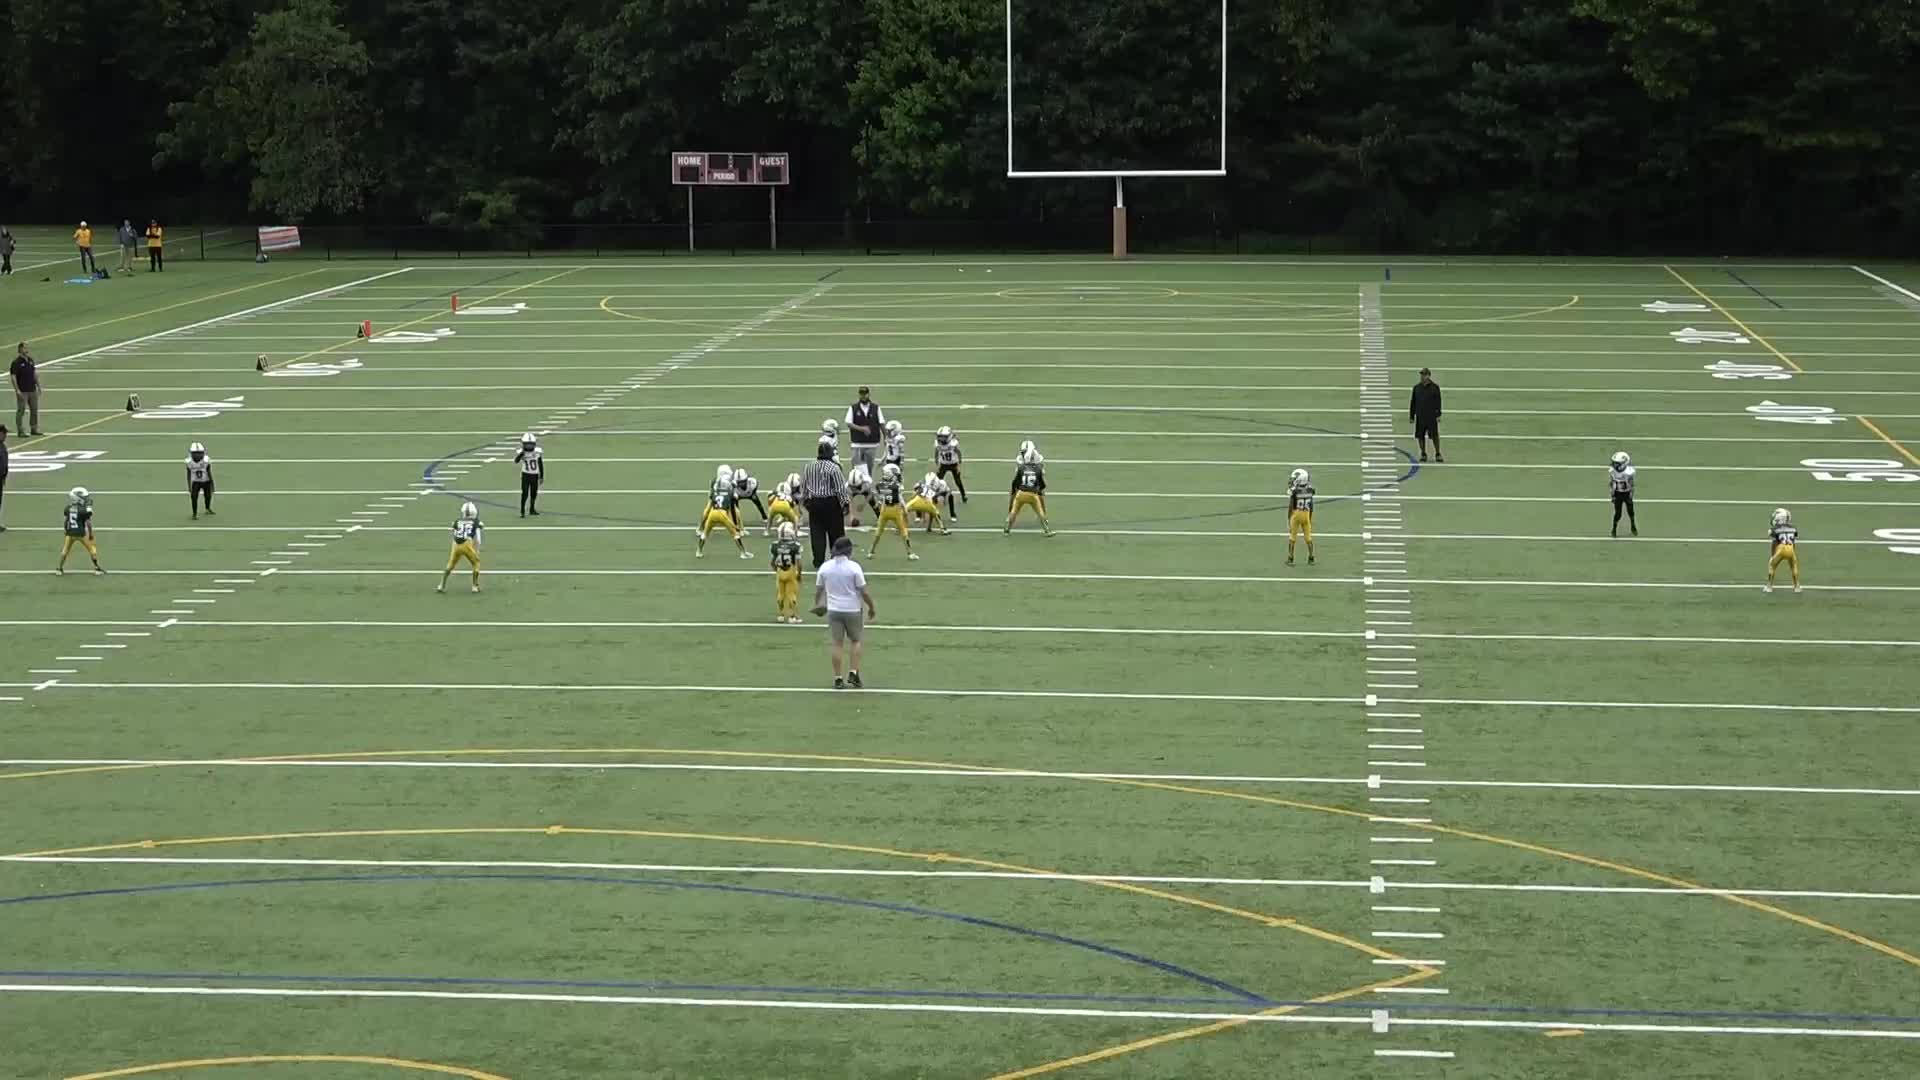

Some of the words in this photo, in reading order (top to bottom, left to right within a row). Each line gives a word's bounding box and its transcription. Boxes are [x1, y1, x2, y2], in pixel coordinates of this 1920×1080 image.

[677, 156, 702, 166] HOME
[759, 156, 786, 166] GUEST
[712, 172, 736, 181] PERIOD
[523, 458, 538, 471] 10
[1800, 458, 1920, 482] 50
[69, 512, 80, 529] 5
